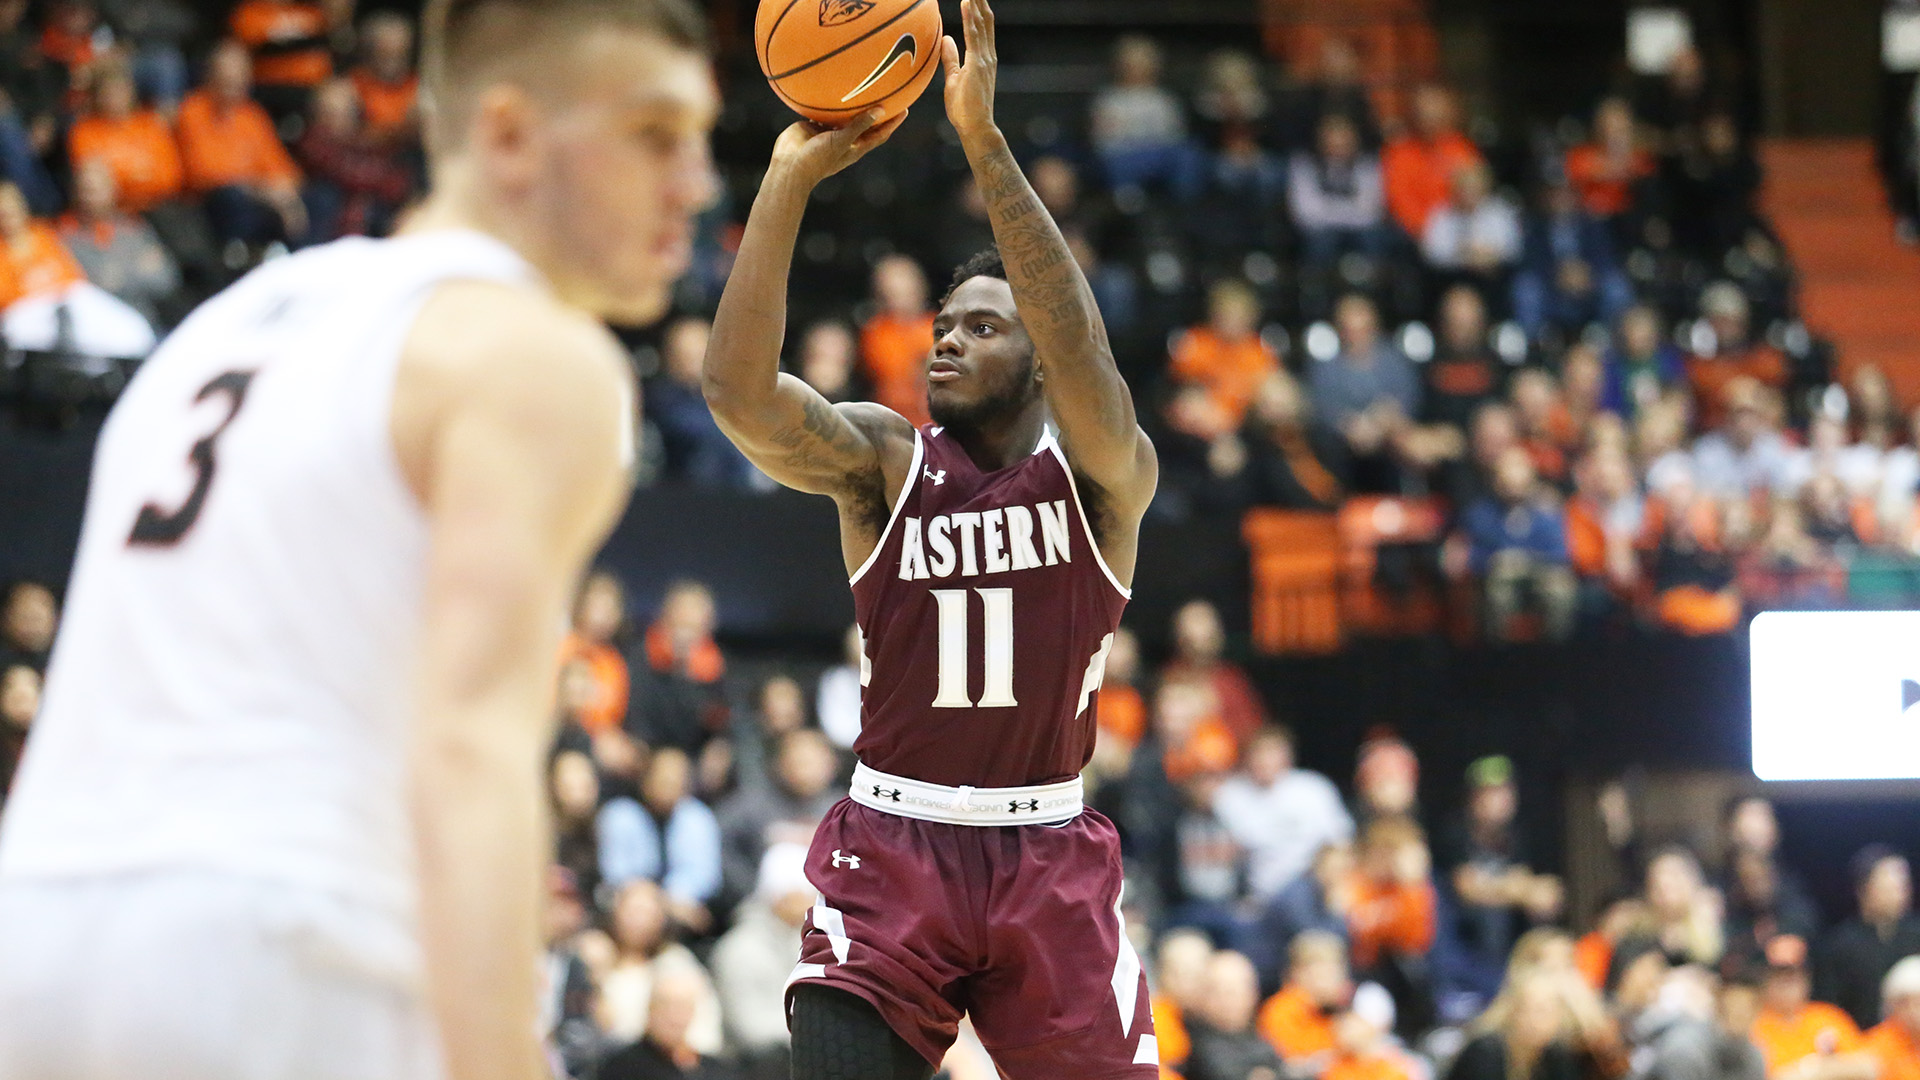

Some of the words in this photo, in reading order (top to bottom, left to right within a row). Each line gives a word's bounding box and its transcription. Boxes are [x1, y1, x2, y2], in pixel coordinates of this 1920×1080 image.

[124, 370, 256, 548] 3
[928, 586, 1019, 709] 11
[968, 803, 1004, 813] UNDE
